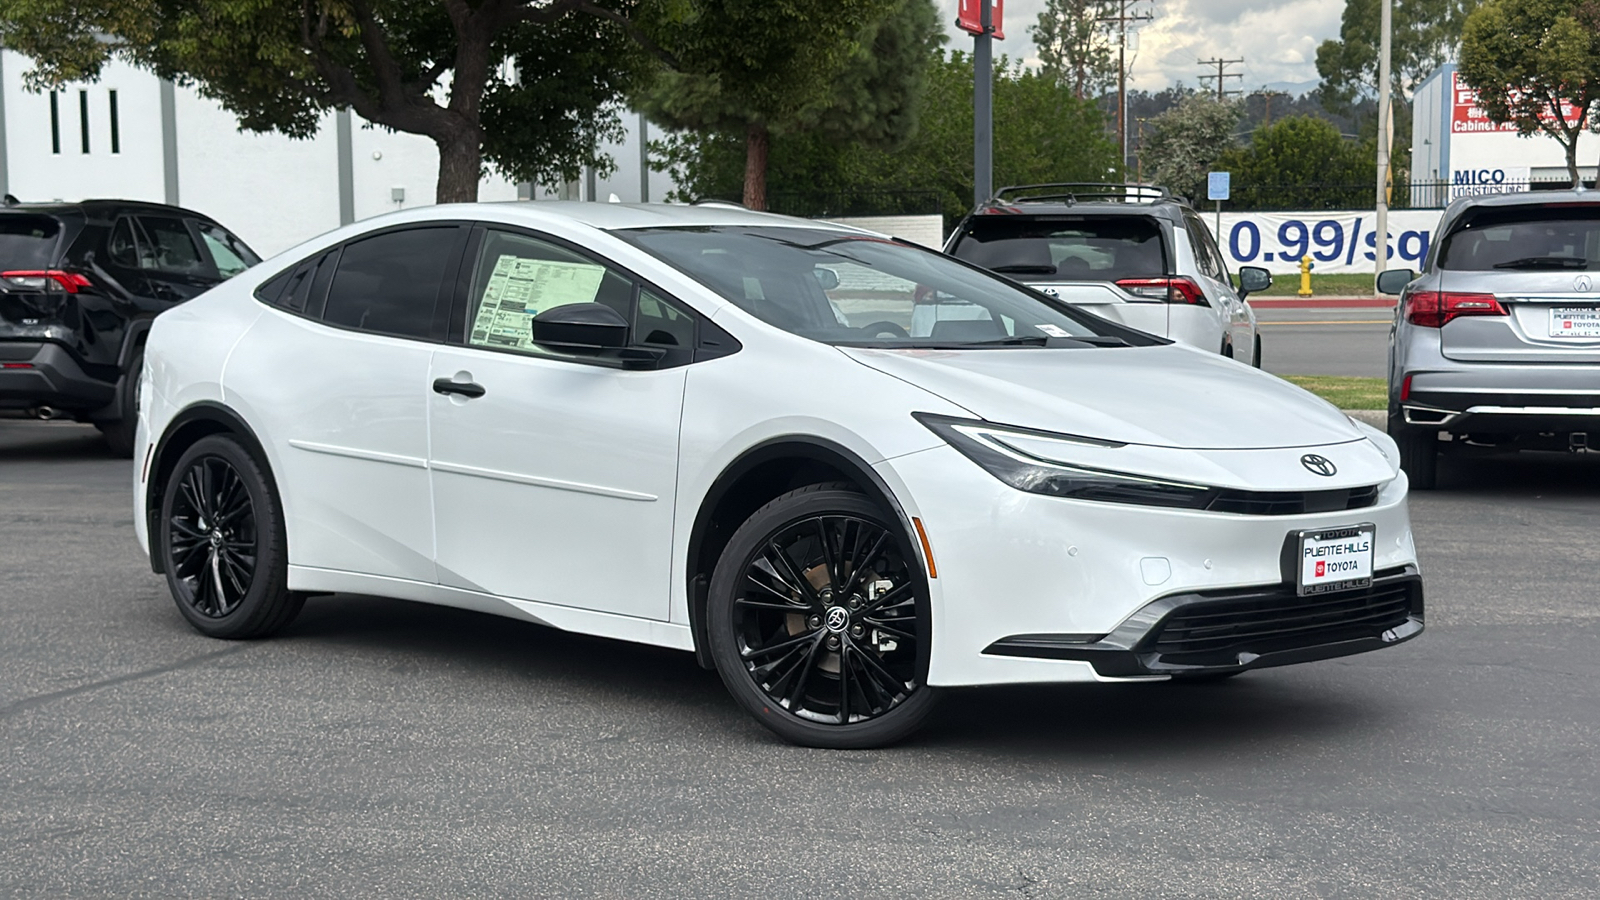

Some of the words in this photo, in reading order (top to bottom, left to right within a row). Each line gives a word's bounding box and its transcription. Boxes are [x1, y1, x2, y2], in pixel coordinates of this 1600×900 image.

[1454, 169, 1505, 185] MICO
[1304, 545, 1342, 557] PUENTE
[1344, 542, 1369, 553] HILLS
[1327, 560, 1358, 573] TOYOTA
[1304, 582, 1341, 594] PUENTE
[1342, 579, 1369, 589] HILLS
